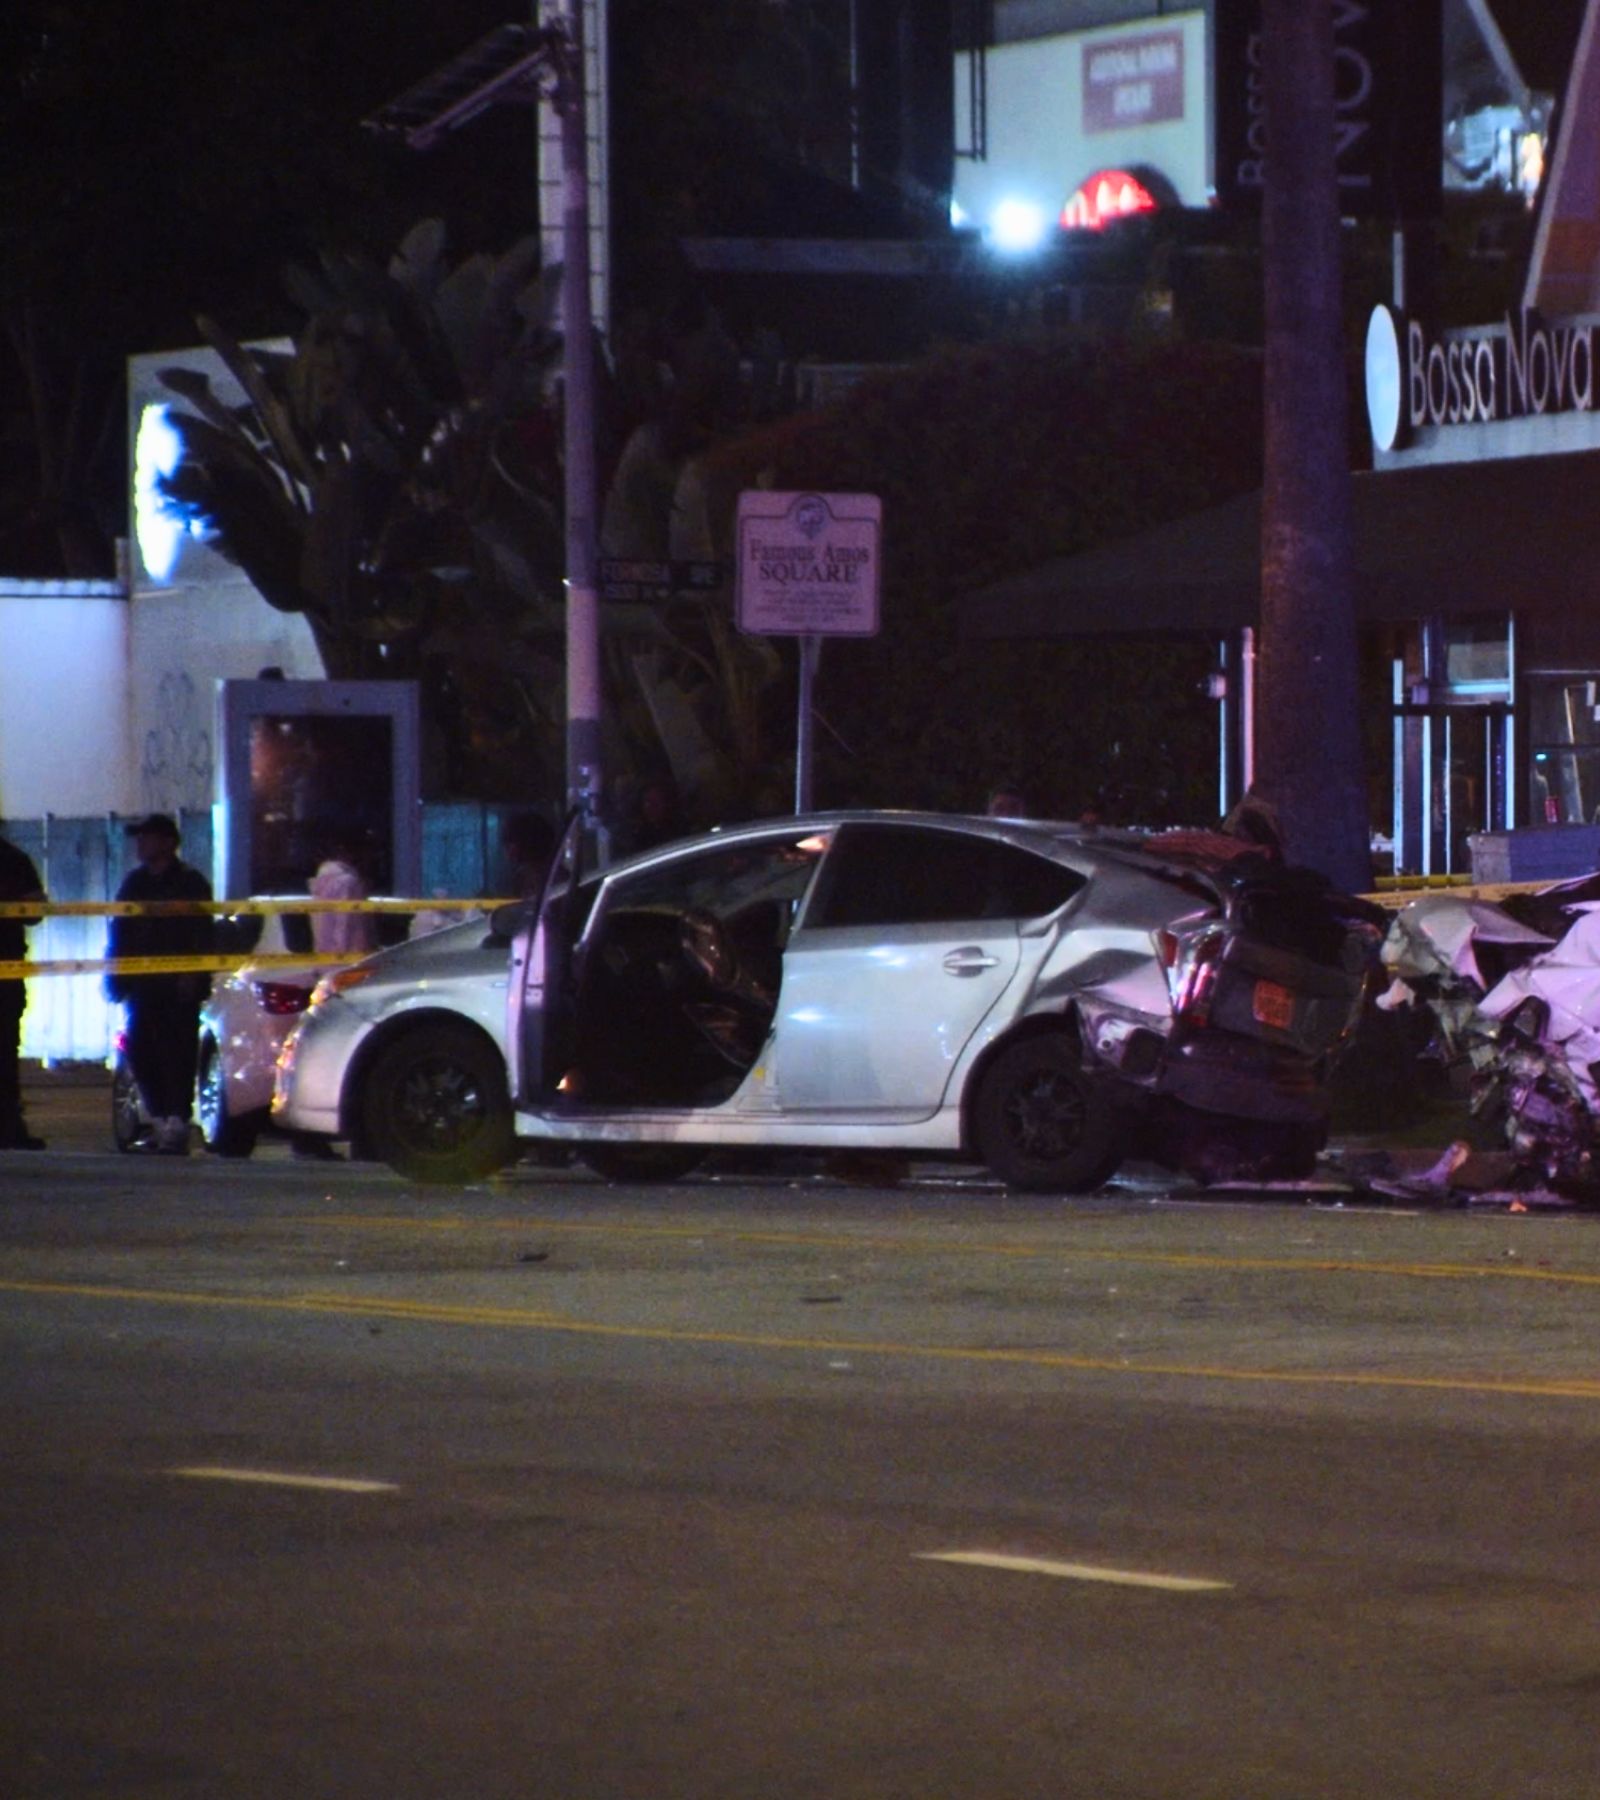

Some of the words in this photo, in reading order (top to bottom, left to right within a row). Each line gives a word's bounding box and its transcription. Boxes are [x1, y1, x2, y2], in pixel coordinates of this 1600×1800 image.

[1408, 318, 1496, 427] Bossa
[1505, 309, 1594, 416] Nova
[749, 538, 815, 561] Famous
[824, 541, 869, 564] Amos
[759, 562, 859, 585] SQUARE
